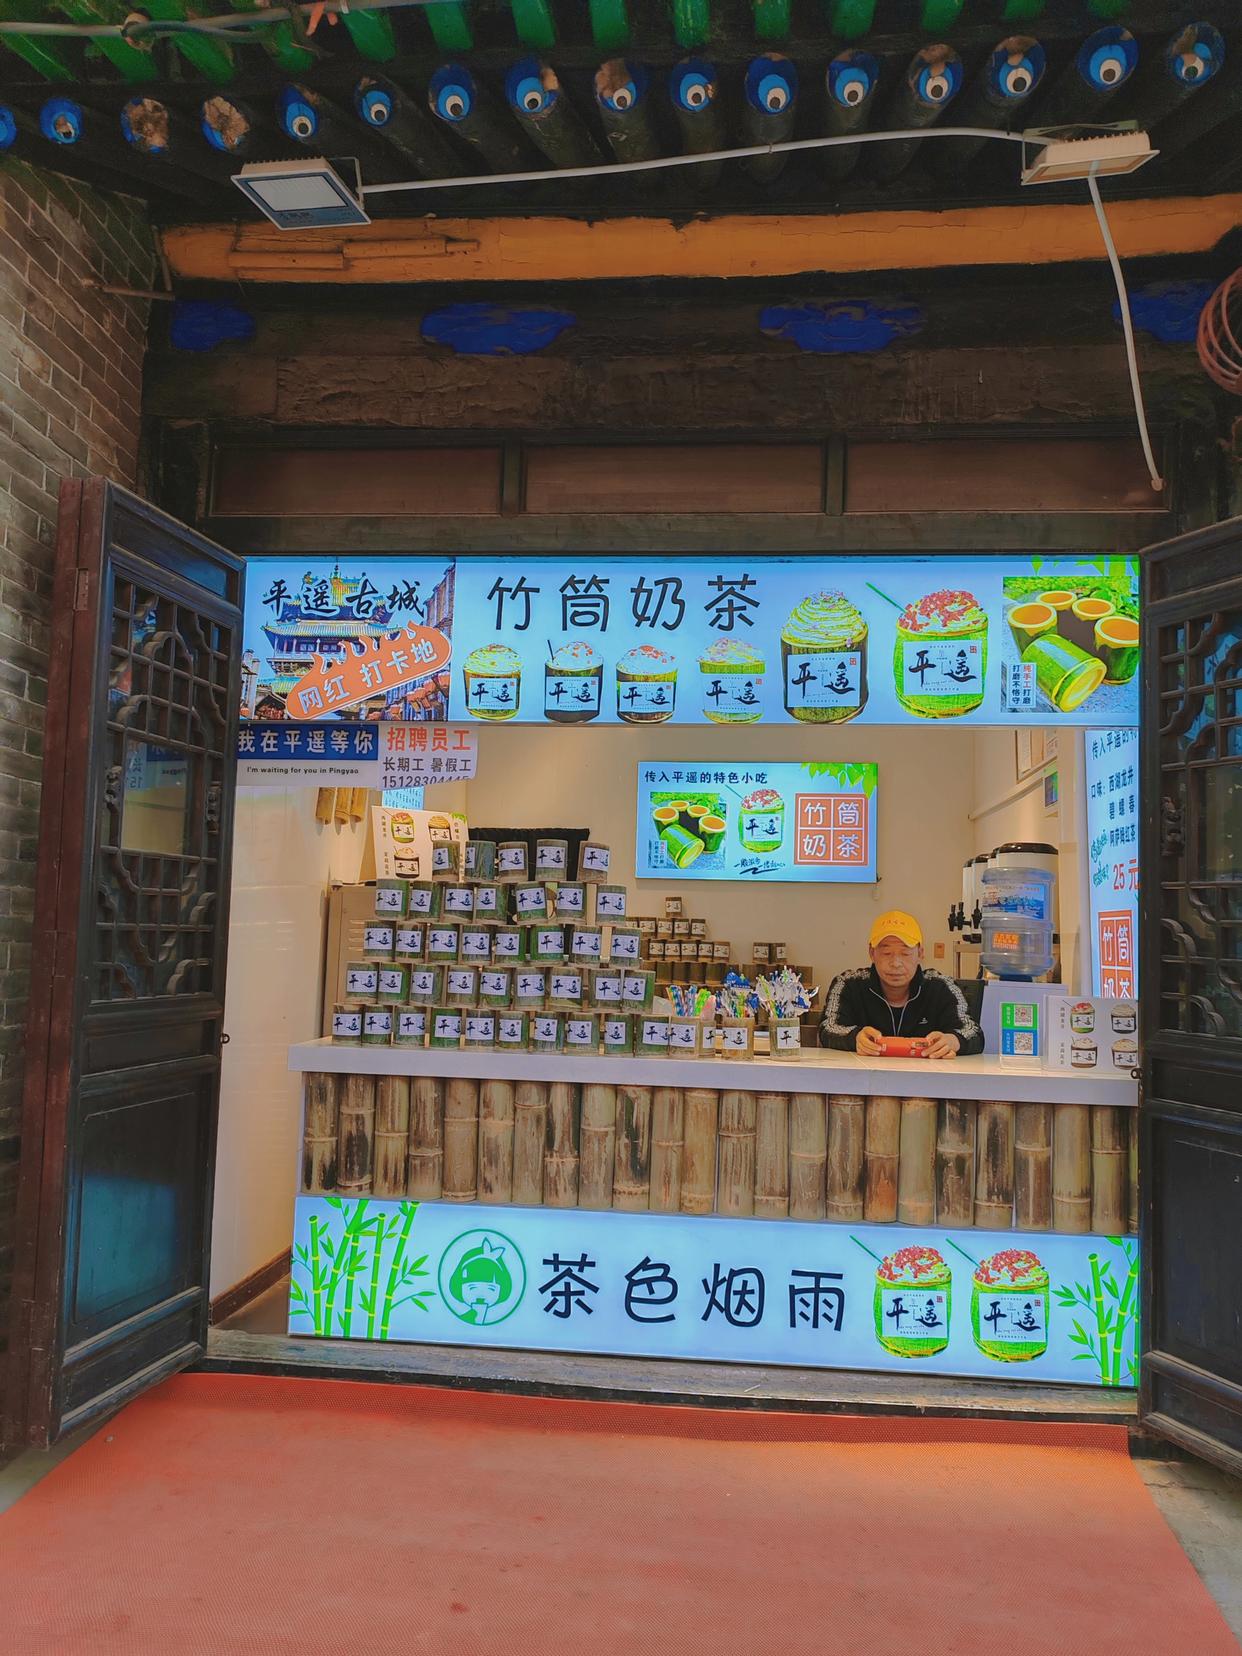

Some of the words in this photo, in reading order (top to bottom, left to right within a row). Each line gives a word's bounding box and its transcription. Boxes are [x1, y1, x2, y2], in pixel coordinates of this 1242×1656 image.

[262, 578, 425, 617] 平遥古城
[487, 573, 761, 632] 竹筒奶茶
[298, 674, 350, 714] 网红
[360, 638, 437, 689] 打卡地
[238, 730, 374, 754] 我在平遥等你
[387, 727, 471, 752] 招聘员工
[261, 766, 288, 774] waiting
[329, 767, 359, 775] Pingyao
[383, 756, 425, 772] 长期工
[431, 757, 472, 773] 暑假工
[382, 776, 469, 788] 151283044
[644, 770, 768, 784] 传入平遥的特色小吃
[804, 802, 859, 826] 竹筒
[803, 835, 860, 858] 奶茶
[1103, 925, 1129, 963] 竹筒
[538, 1253, 846, 1333] 茶色烟雨
